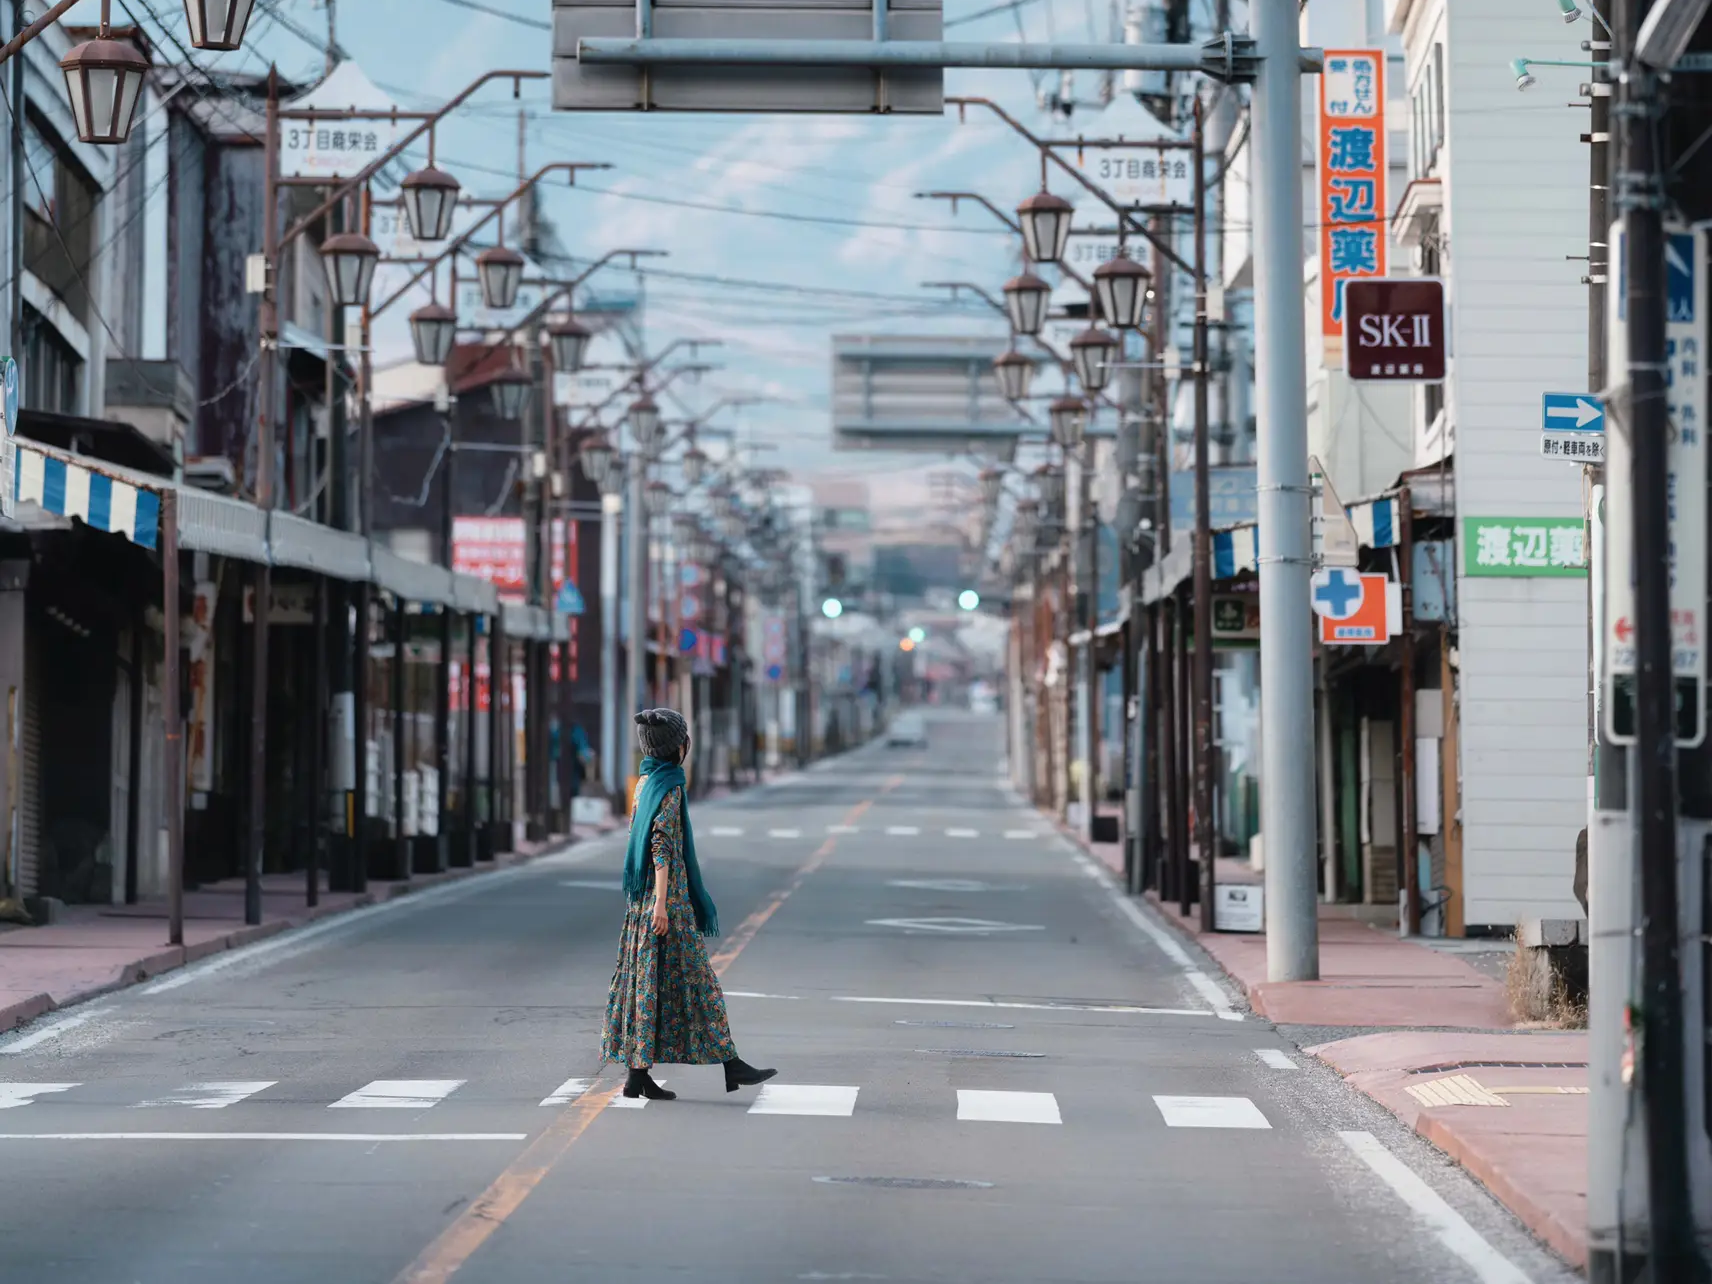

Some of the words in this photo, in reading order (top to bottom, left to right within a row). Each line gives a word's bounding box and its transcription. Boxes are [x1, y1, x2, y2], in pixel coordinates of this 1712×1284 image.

[288, 129, 377, 152] 3丁目商栄会
[1100, 158, 1187, 180] 3丁目商栄会
[1329, 127, 1377, 323] 渡辺薬
